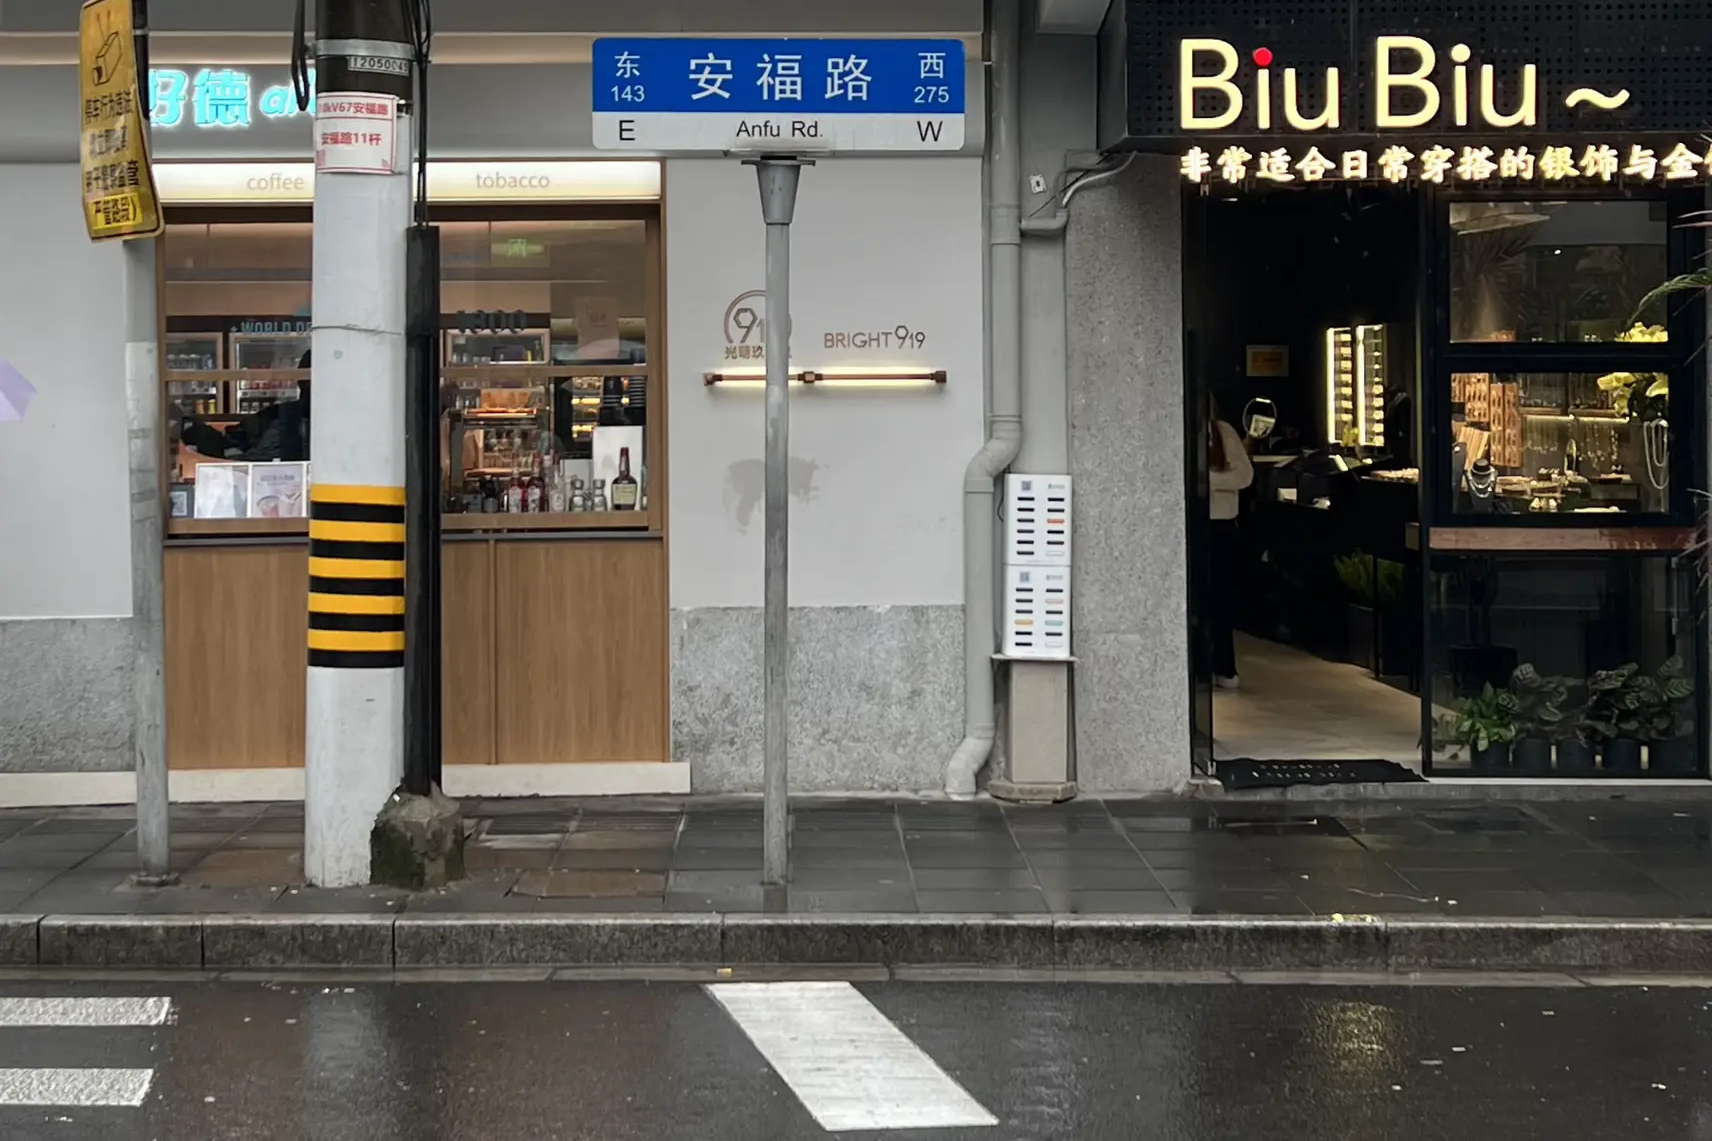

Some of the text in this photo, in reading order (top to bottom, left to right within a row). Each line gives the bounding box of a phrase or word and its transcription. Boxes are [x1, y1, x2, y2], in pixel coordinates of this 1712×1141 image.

[613, 51, 641, 79] 东
[917, 52, 946, 79] 西
[688, 52, 872, 101] 安福路
[1180, 38, 1340, 130] Biu
[1376, 36, 1537, 128] Biu
[610, 85, 645, 102] 143
[913, 86, 950, 103] 275
[618, 120, 636, 141] E
[736, 119, 824, 138] Anfu Rd.
[916, 121, 943, 142] W
[246, 173, 305, 190] coffee
[476, 171, 550, 189] tobacco
[241, 321, 292, 334] WORLD
